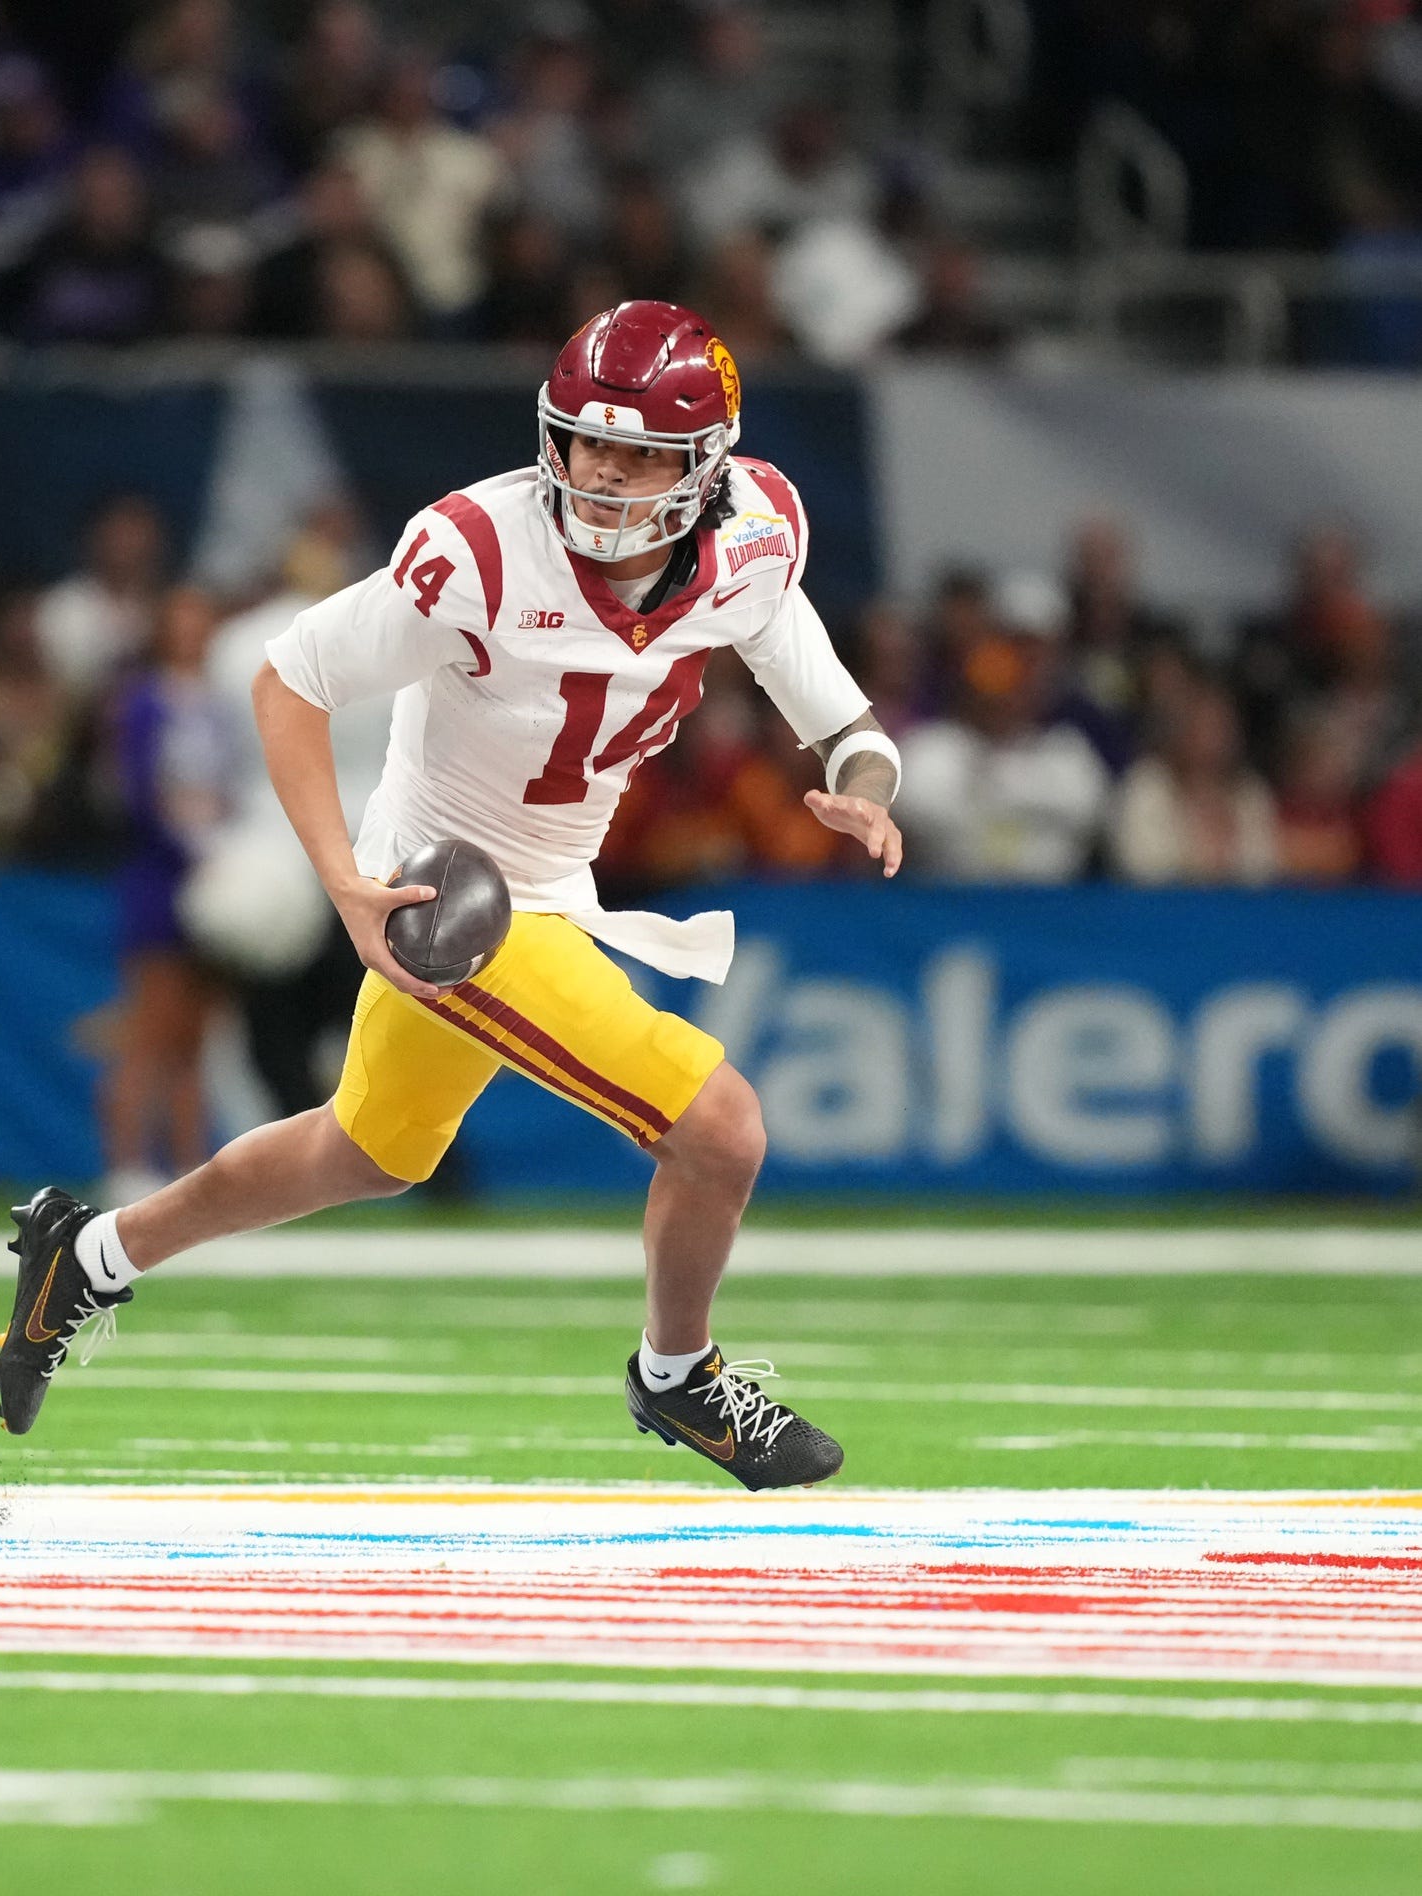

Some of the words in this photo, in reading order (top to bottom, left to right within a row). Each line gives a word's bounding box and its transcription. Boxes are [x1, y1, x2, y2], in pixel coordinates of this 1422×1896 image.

[545, 439, 568, 482] TROJANS
[733, 526, 773, 543] Valero
[393, 527, 456, 618] 14
[523, 647, 712, 804] 14
